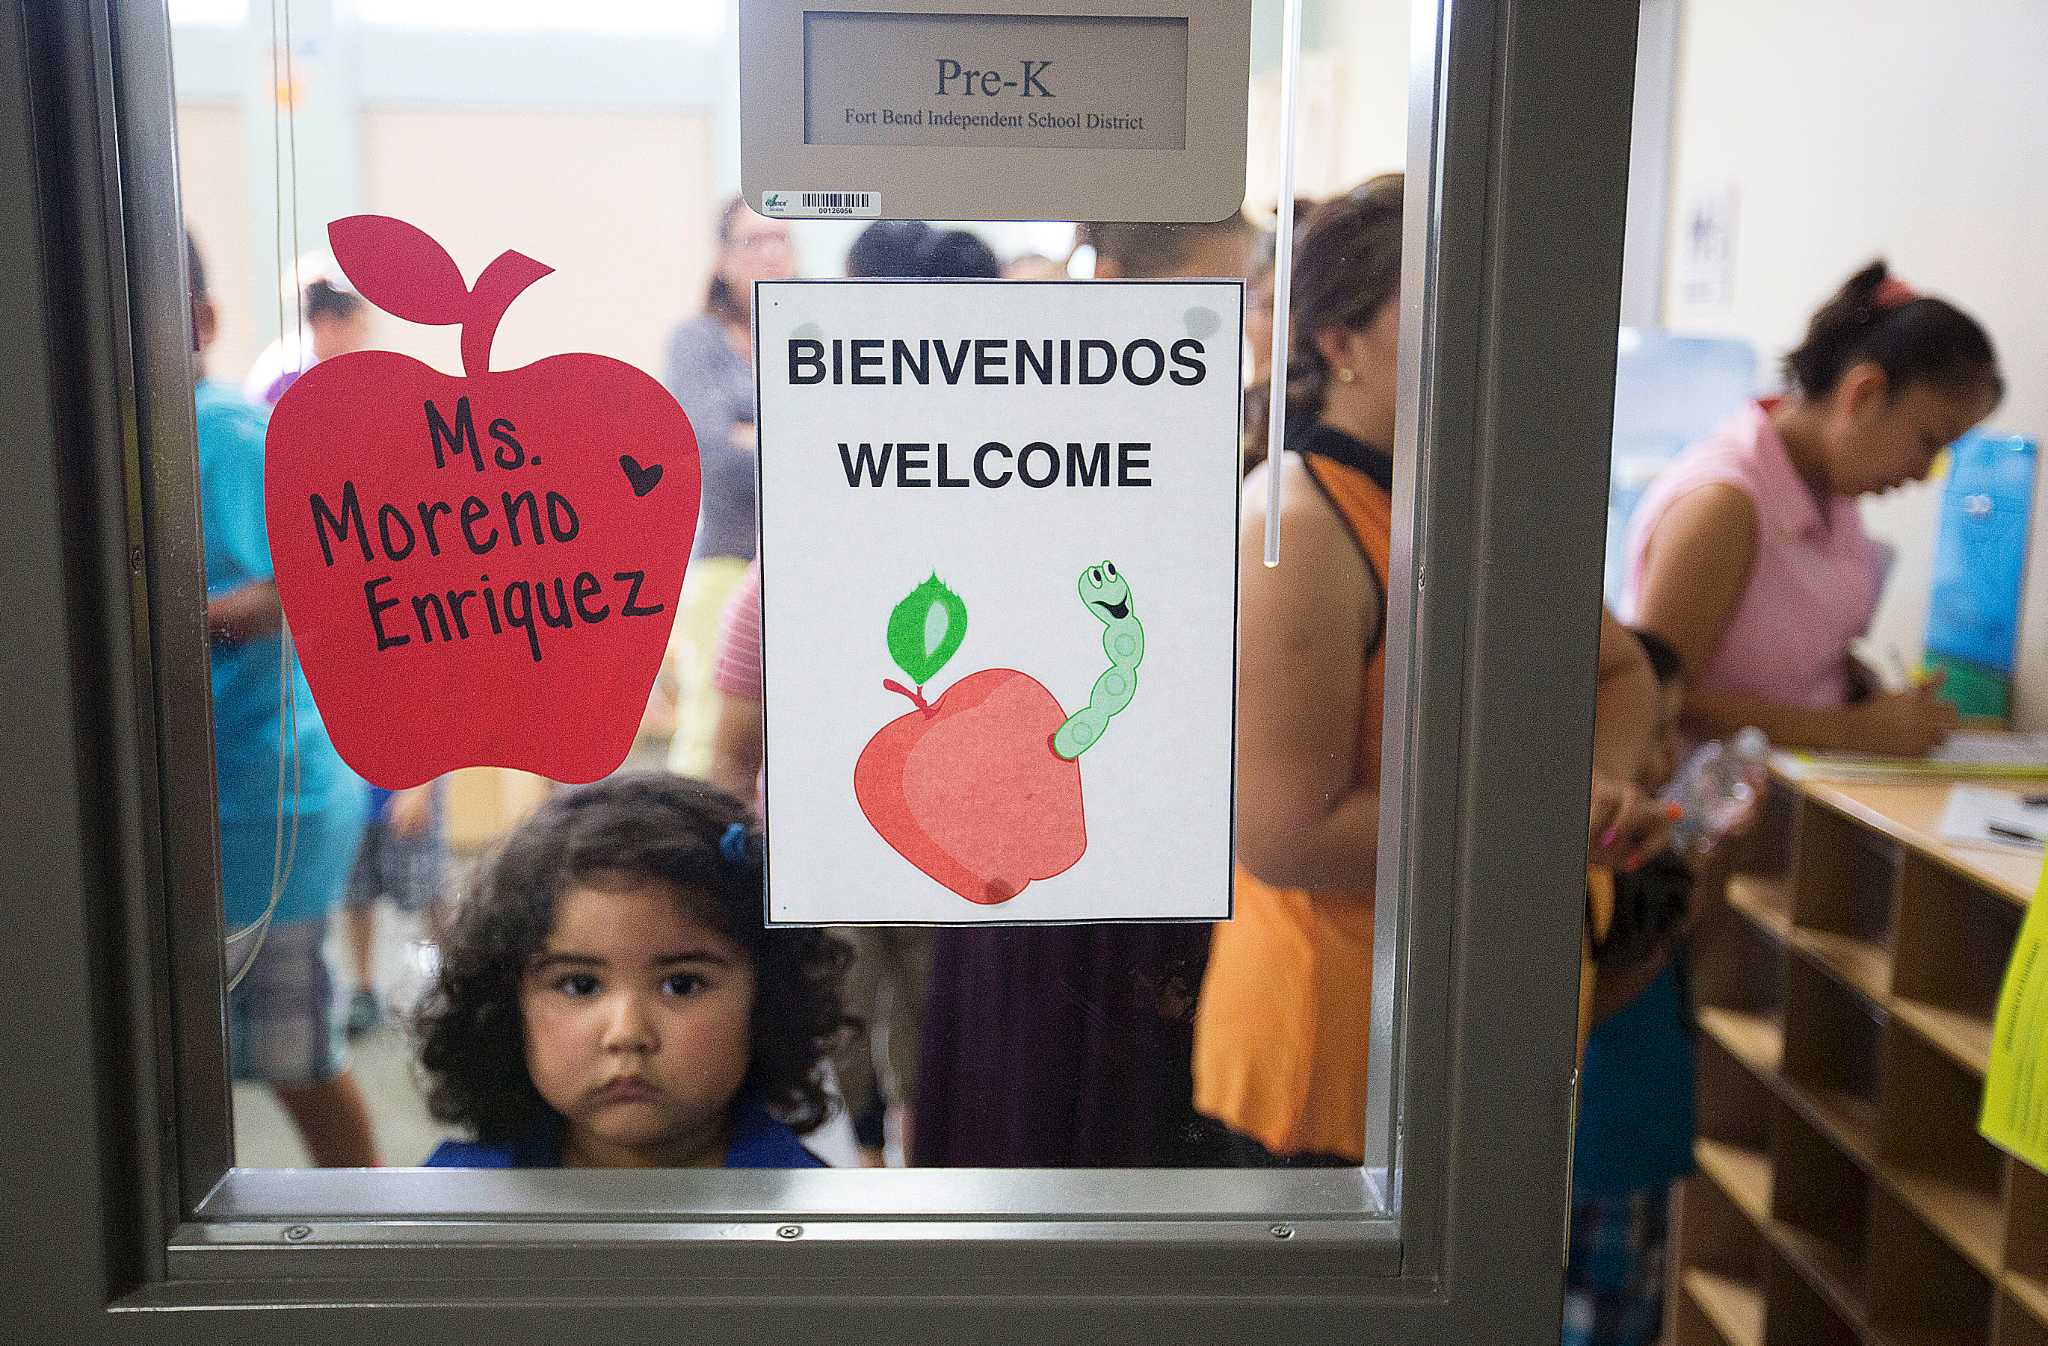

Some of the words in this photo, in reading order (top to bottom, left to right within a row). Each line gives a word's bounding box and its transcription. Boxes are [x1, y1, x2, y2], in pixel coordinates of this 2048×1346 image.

[935, 58, 1056, 98] Pre-K
[845, 108, 877, 125] Fort
[882, 109, 923, 126] Bend
[928, 110, 1023, 130] Independent
[1028, 112, 1081, 128] School
[1086, 112, 1144, 129] District
[787, 338, 1207, 386] BIENVENIDOS
[424, 396, 541, 472] Ms.
[838, 441, 1152, 488] WELCOME
[309, 480, 580, 567] Moreno
[363, 570, 665, 660] Enriquez
